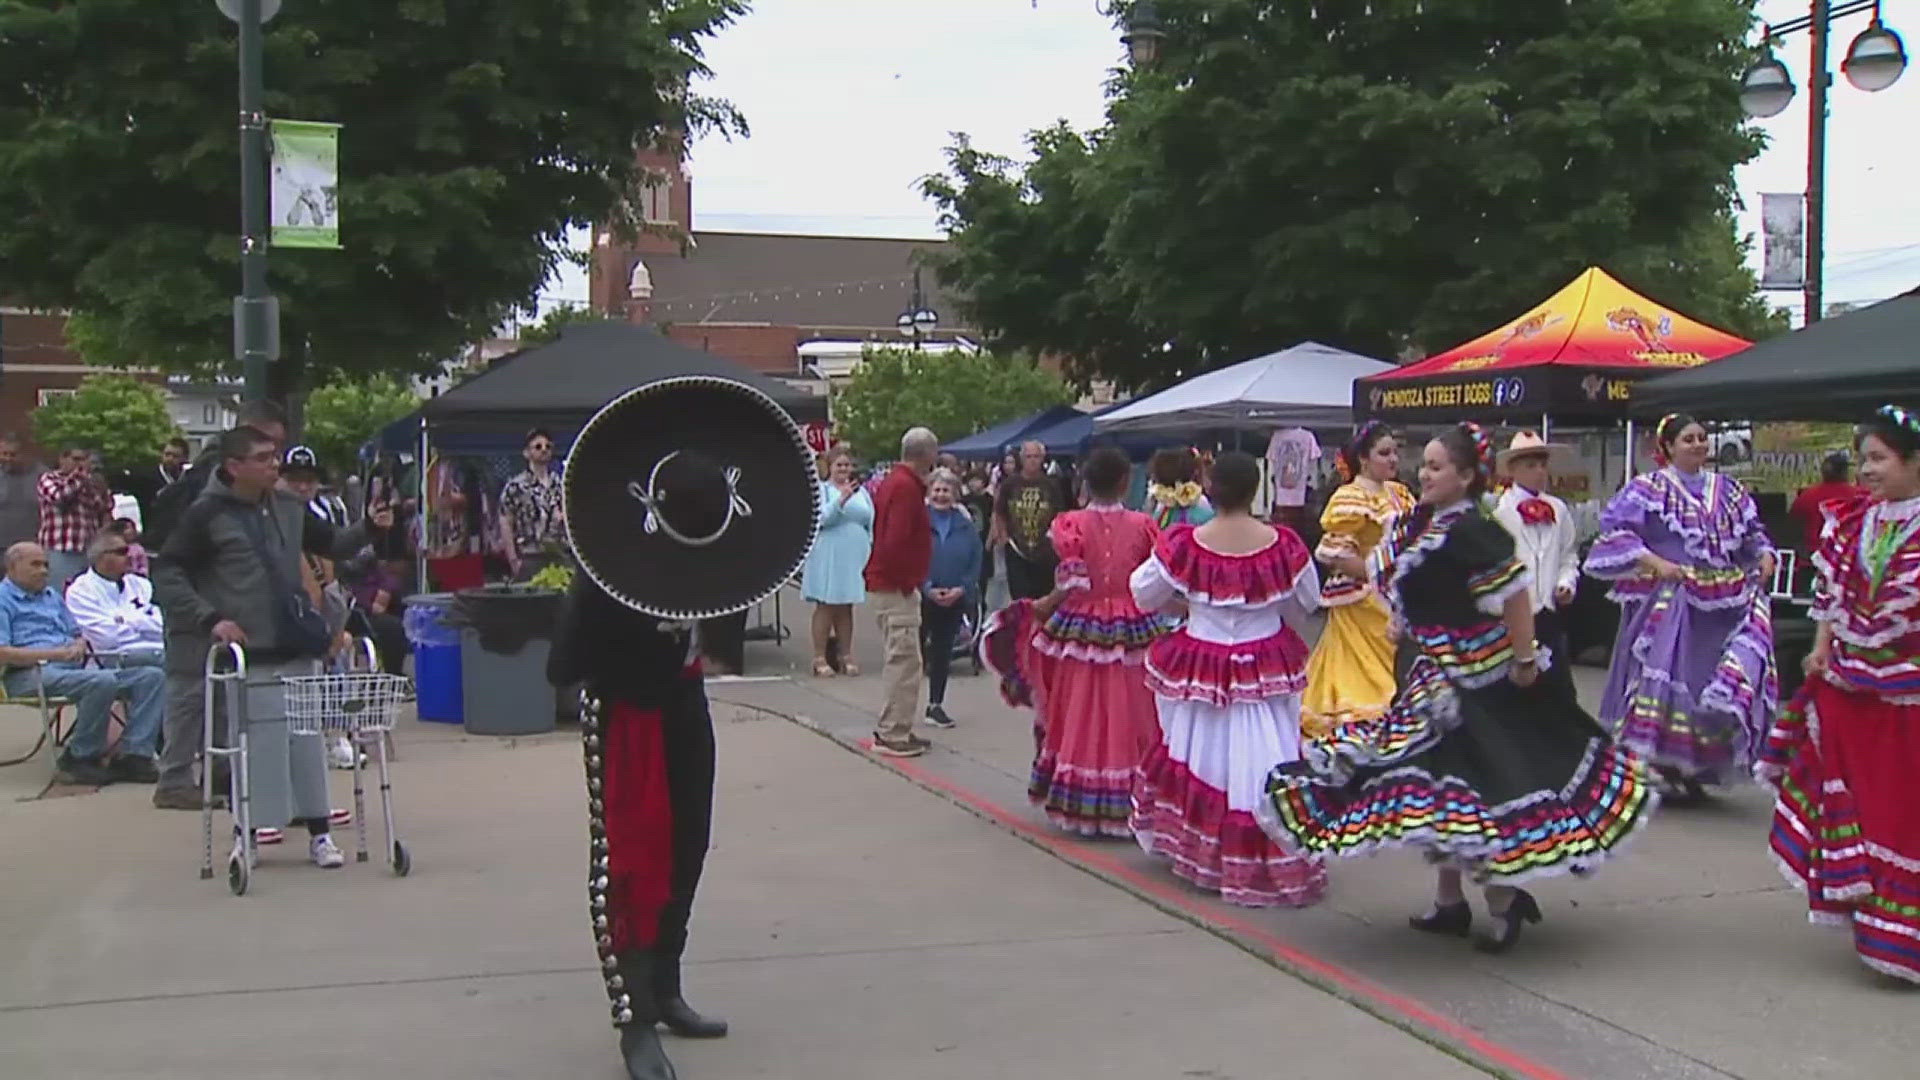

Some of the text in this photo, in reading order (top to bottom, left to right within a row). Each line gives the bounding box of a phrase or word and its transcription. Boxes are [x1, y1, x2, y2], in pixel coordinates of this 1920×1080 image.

[1382, 388, 1424, 408] MENDOZA
[1425, 384, 1462, 407] STREET
[1464, 382, 1492, 405] DOGS
[1607, 380, 1631, 401] ME
